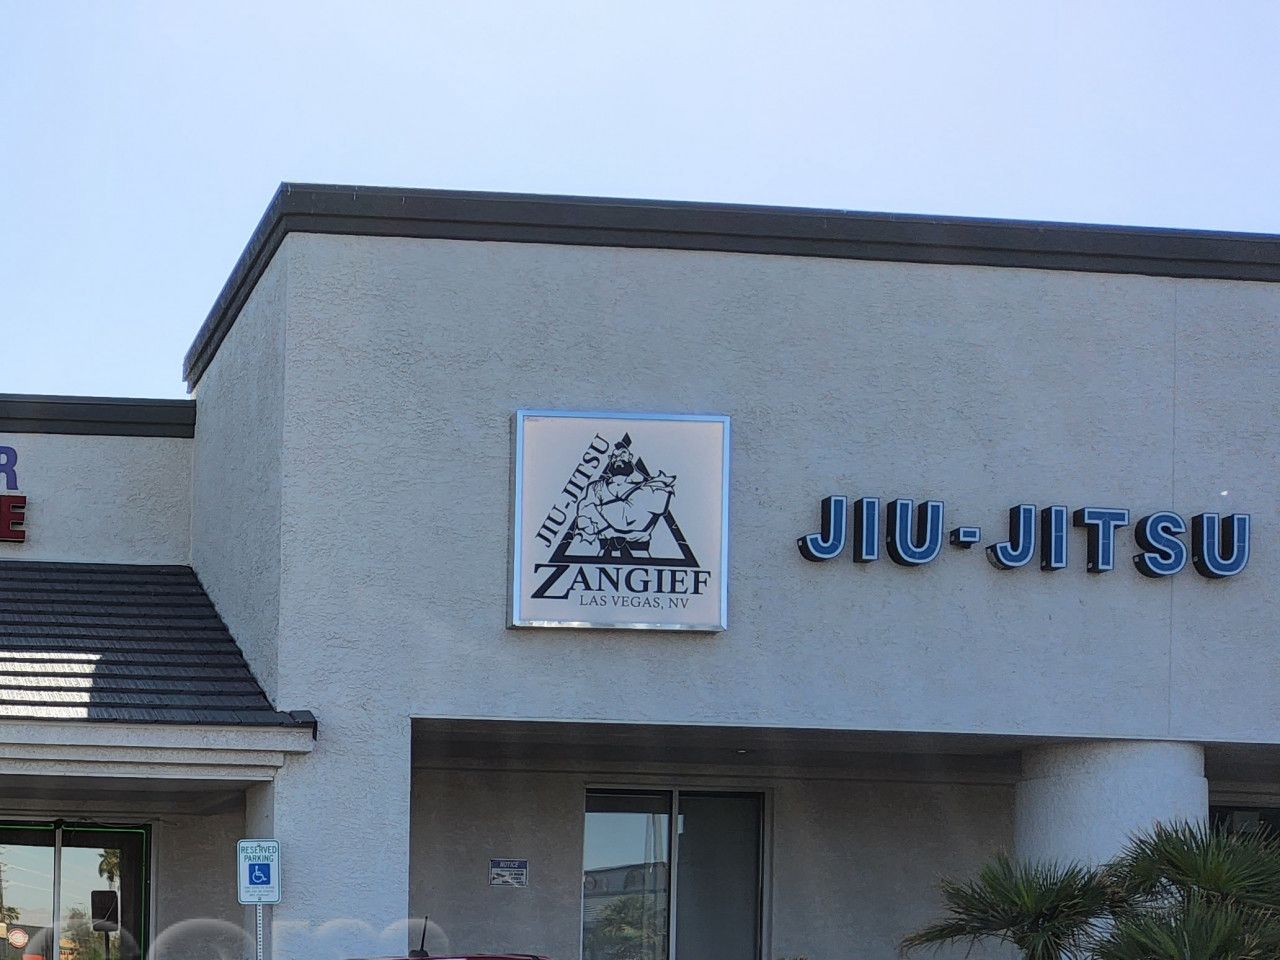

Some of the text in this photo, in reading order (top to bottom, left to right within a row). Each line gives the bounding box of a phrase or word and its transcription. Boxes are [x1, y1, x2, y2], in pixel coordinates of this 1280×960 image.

[535, 433, 610, 548] JIU-JITSU
[797, 495, 1251, 579] JIU-JITSU
[530, 563, 712, 600] ZANGIEF
[580, 595, 689, 610] LAS VEGAS, NV
[241, 845, 277, 854] RESERVED
